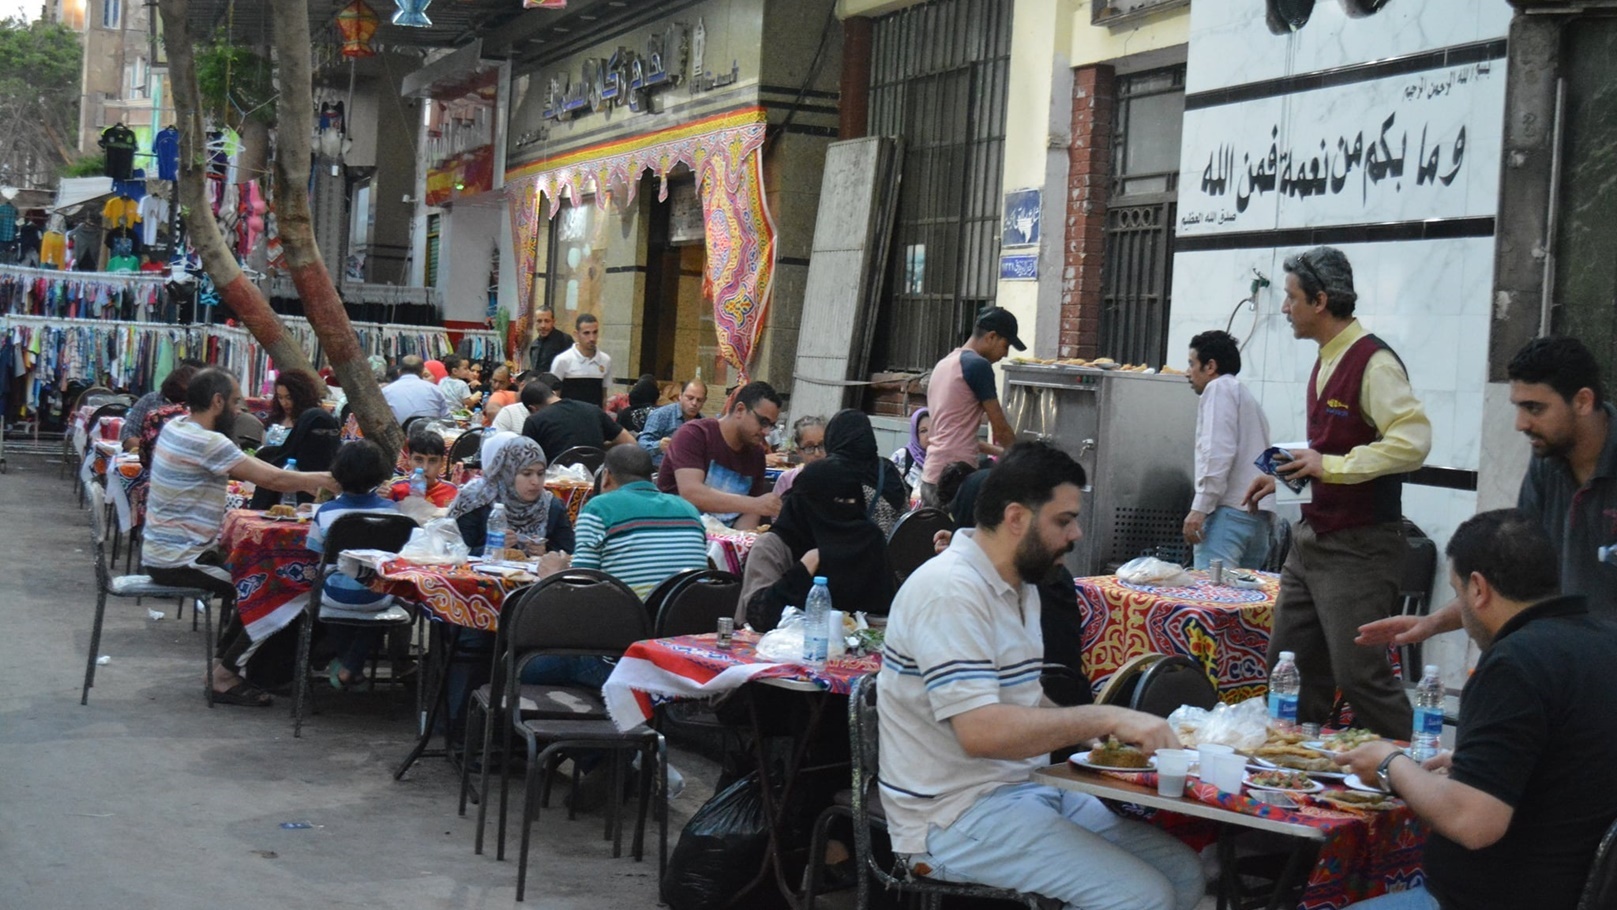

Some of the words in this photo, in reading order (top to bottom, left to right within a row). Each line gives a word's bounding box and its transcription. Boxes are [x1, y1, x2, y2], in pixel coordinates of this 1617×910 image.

[1201, 141, 1235, 196] الله
[1236, 124, 1278, 213] فمن
[1280, 138, 1329, 201] نعمة
[1331, 130, 1363, 194] من
[1363, 111, 1407, 207] بكم
